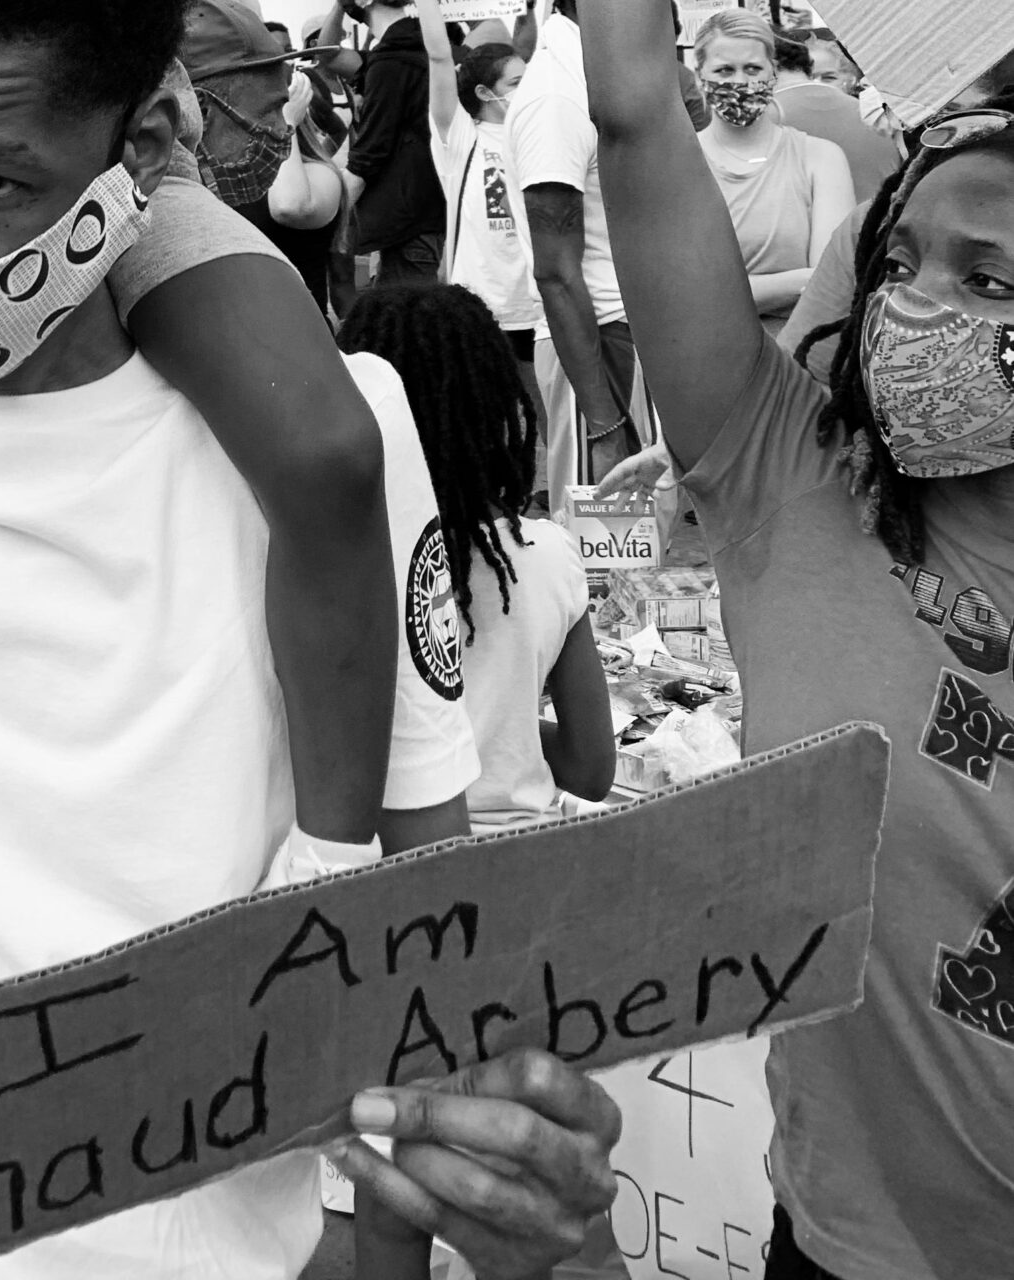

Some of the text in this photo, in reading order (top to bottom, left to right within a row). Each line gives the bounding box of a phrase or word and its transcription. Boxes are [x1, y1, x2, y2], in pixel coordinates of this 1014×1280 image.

[578, 504, 607, 513] VALUE
[579, 528, 652, 558] belVita
[250, 902, 478, 1007] Am
[387, 923, 830, 1087] Arbery
